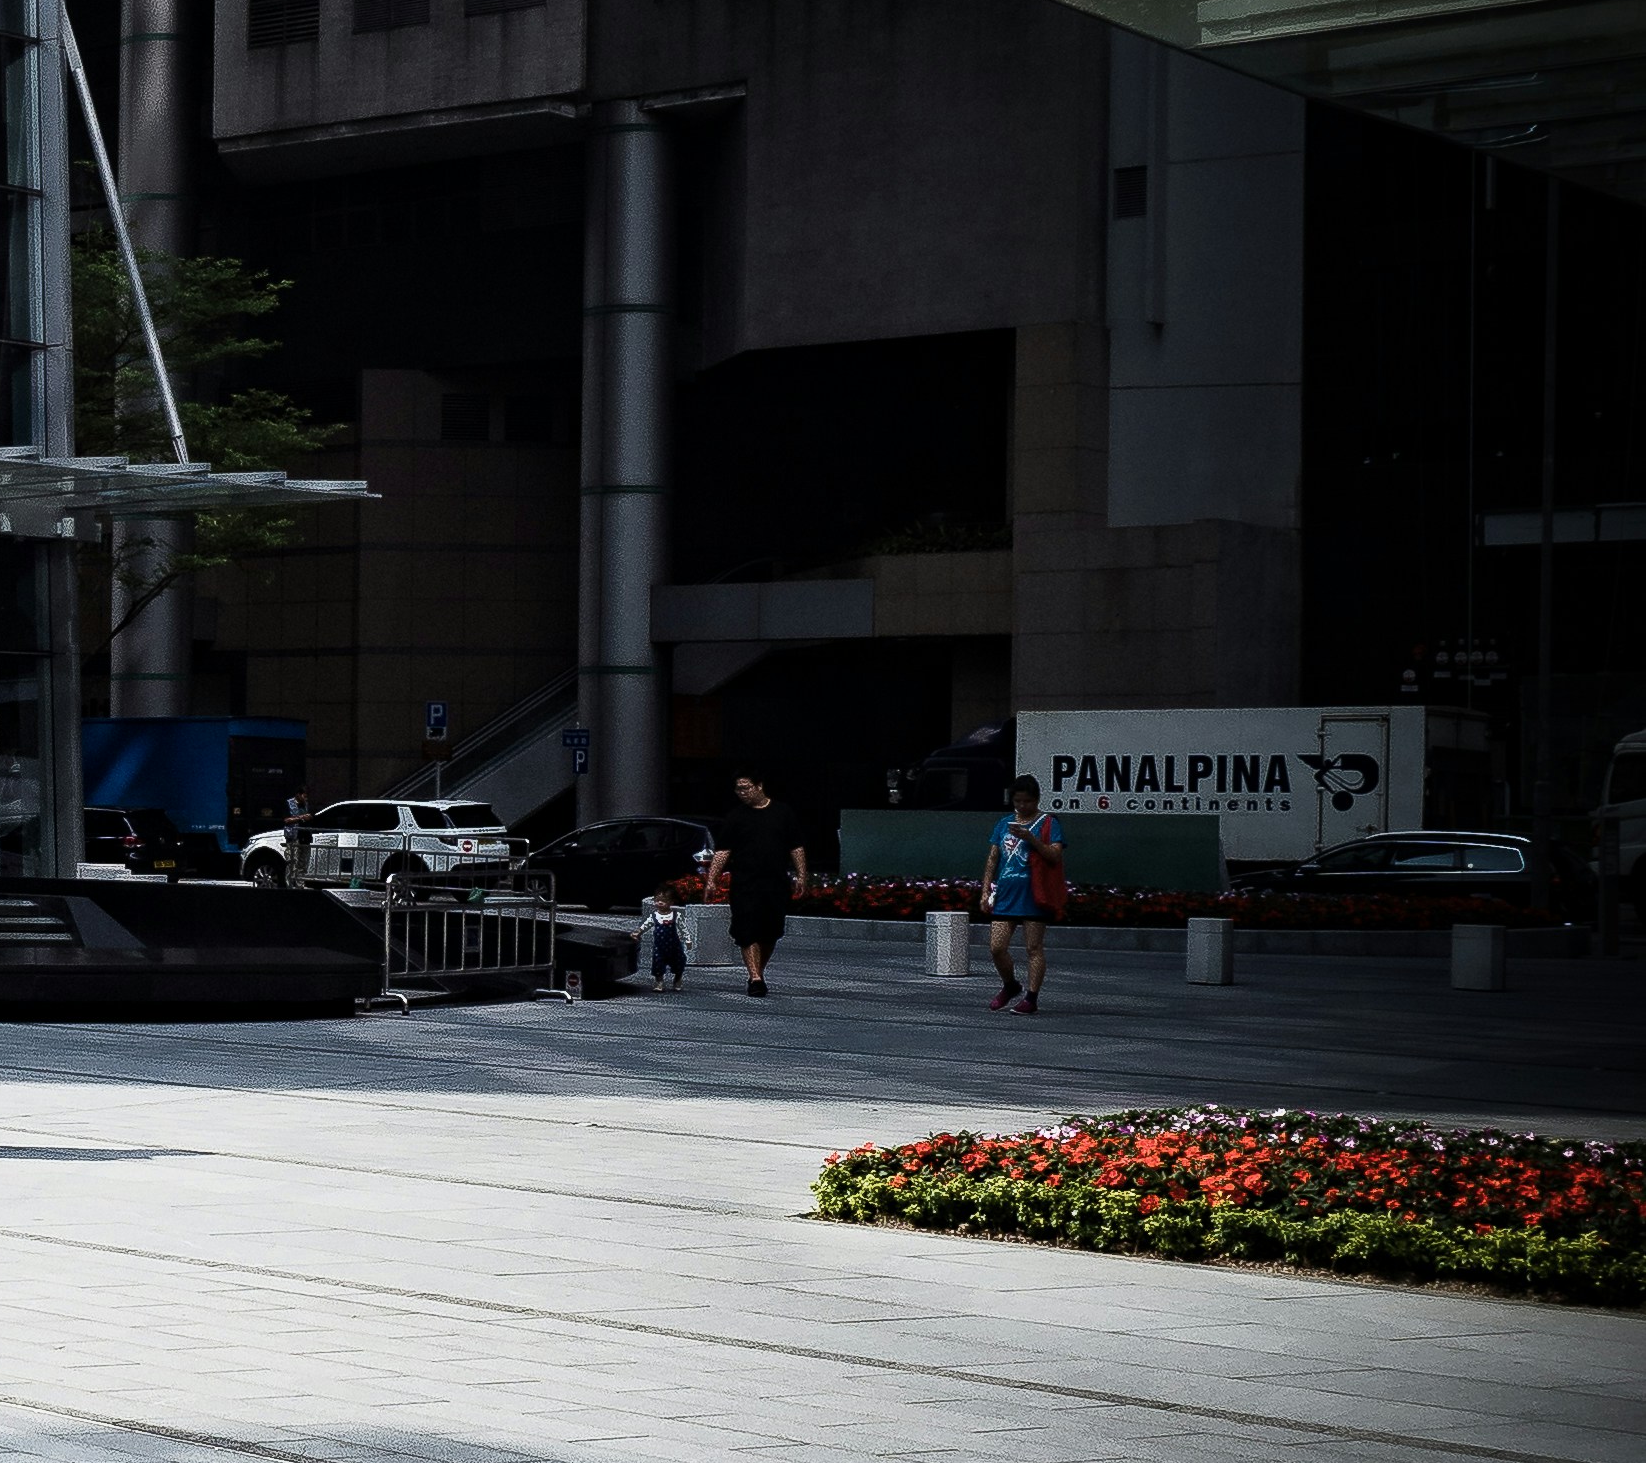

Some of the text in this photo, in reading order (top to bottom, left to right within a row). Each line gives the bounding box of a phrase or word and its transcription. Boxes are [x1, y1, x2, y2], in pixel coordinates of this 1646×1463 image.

[430, 704, 444, 725] P
[576, 750, 586, 773] P
[1051, 754, 1291, 793] PANALPINA
[1051, 797, 1291, 811] on 6 continents
